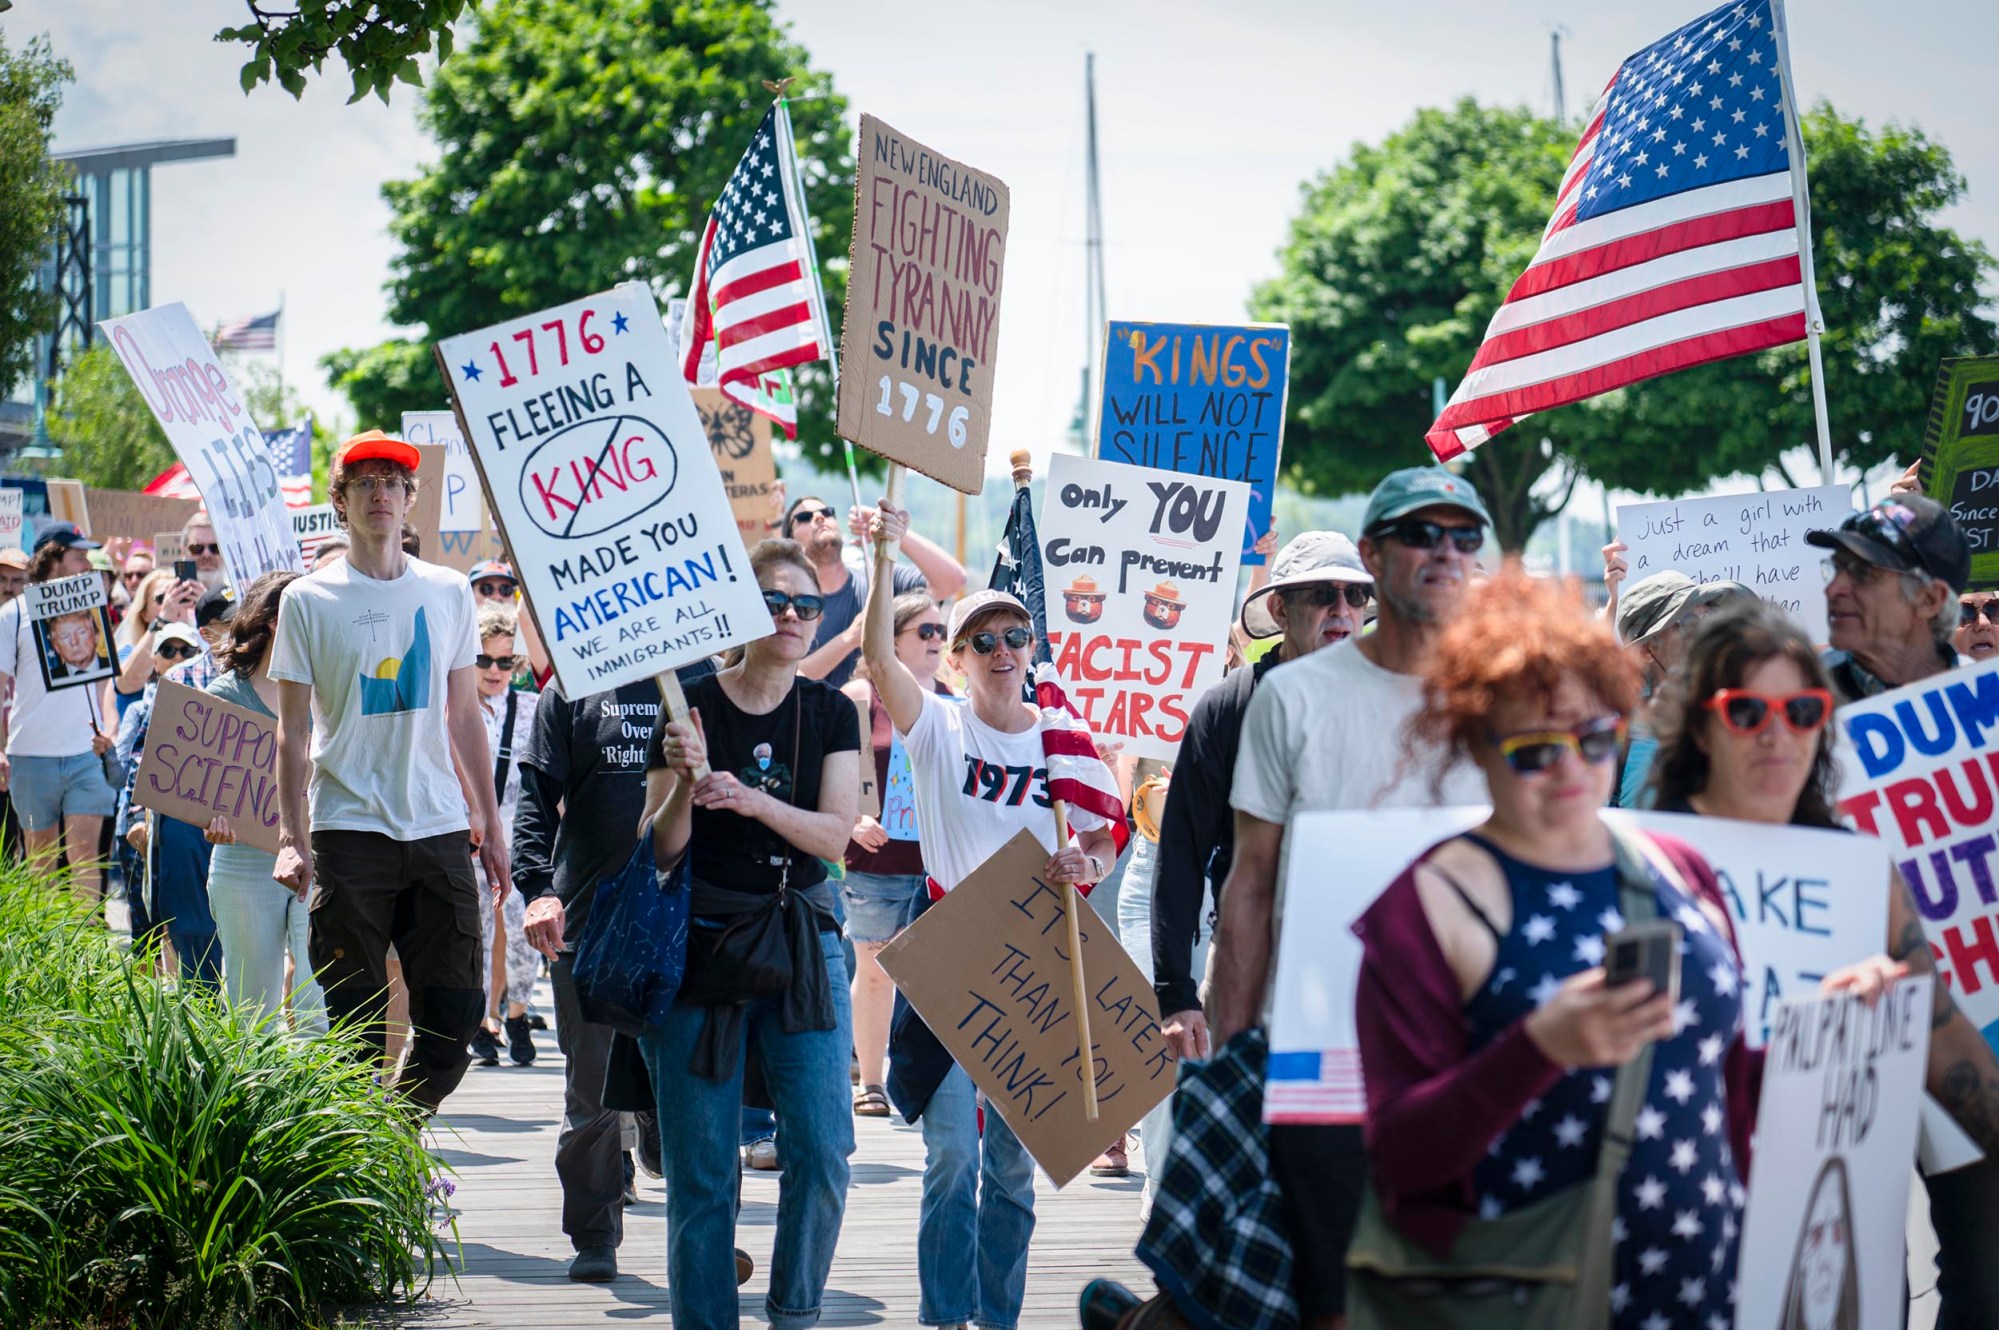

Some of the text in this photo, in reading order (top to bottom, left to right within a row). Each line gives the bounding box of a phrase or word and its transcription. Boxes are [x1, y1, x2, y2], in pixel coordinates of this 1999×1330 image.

[875, 130, 998, 217] NEW ENGLAND
[870, 176, 1002, 298] FIGHTING
[870, 242, 996, 367] TYRANNY
[114, 325, 241, 435] Orange
[489, 309, 606, 388] 1776
[872, 320, 976, 397] SINCE
[486, 361, 652, 451] FLEEING A
[876, 374, 970, 450] 1776
[1110, 391, 1275, 428] WILL NOT
[530, 436, 658, 521] KING
[1113, 429, 1270, 484] SILENCE
[1146, 481, 1227, 543] YOU
[1637, 494, 1824, 541] just a girl with
[1950, 500, 1998, 521] Since
[548, 512, 698, 592] MADE YOU
[1118, 550, 1223, 594] prevent
[1638, 554, 1650, 569] a
[1673, 539, 1730, 562] dream
[1751, 528, 1791, 553] that
[1755, 564, 1801, 585] have
[35, 591, 101, 616] TRUMP
[39, 577, 93, 600] DUMP
[555, 543, 738, 642] AMERICAN!
[572, 600, 716, 660] WE ARE ALL
[586, 614, 733, 681] IMMIGRANTS!!
[601, 700, 660, 719] Suprem
[1076, 687, 1190, 743] IARS
[1844, 671, 1999, 780] DUM
[149, 743, 281, 828] SCIENC
[962, 753, 1054, 810] 1973
[1835, 748, 1999, 850] TRU
[1713, 867, 1832, 937] AKE
[991, 943, 1070, 1035] THAN
[957, 989, 1069, 1123] THINK!
